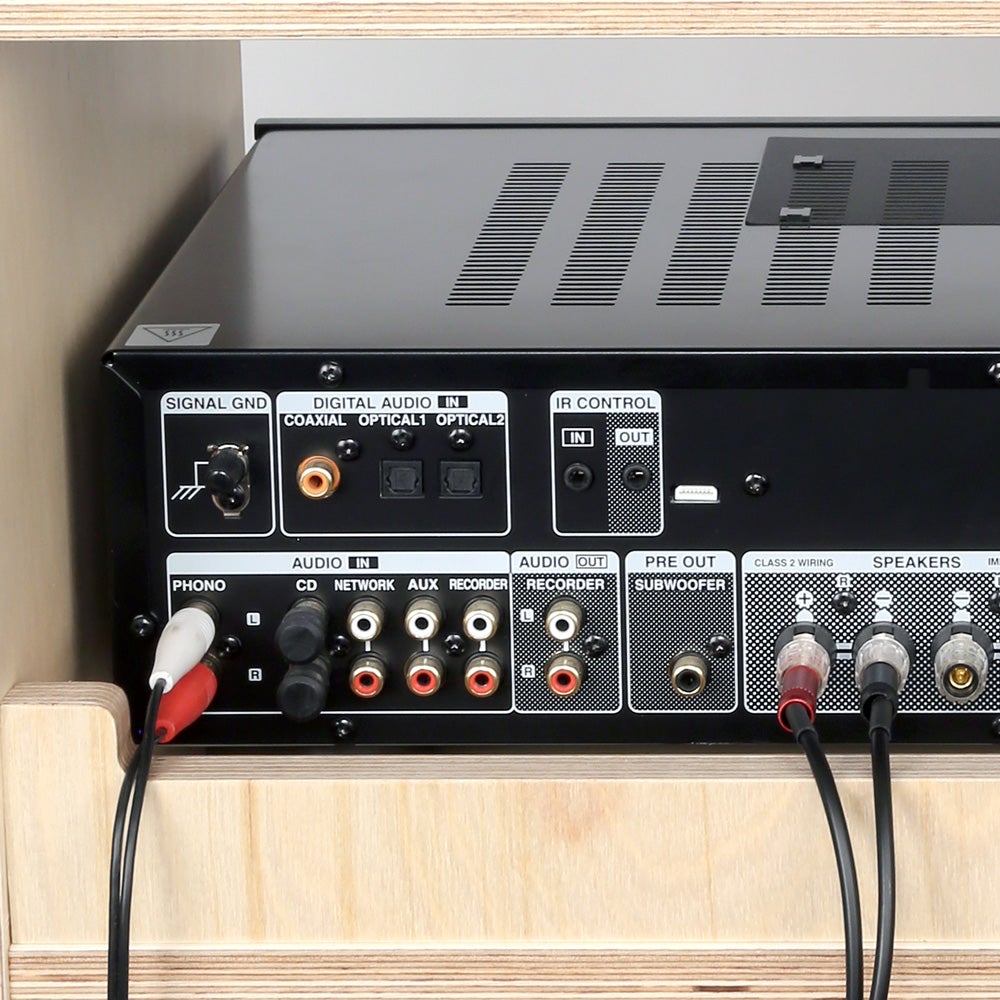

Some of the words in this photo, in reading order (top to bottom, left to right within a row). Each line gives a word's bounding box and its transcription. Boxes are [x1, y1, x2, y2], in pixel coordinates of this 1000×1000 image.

[166, 397, 227, 409] SIGNAL
[232, 397, 267, 409] GND
[314, 397, 377, 409] DIGITAL
[382, 397, 431, 409] AUDIO
[445, 396, 459, 408] IN
[557, 398, 571, 409] IR
[577, 397, 655, 409] CONTROL
[284, 414, 347, 426] COAXIAL
[358, 414, 426, 426] OPTICAL1
[436, 414, 505, 426] OPTICAL2
[570, 432, 585, 443] IN
[620, 432, 650, 443] OUT
[292, 556, 342, 570] AUDIO
[356, 557, 370, 569] IN
[519, 556, 569, 569] AUDIO
[579, 557, 604, 567] OUT
[645, 556, 677, 568] PRE
[682, 556, 716, 568] OUT
[754, 558, 786, 567] CLASS
[788, 558, 796, 567] 2
[798, 558, 834, 567] WIRING
[873, 556, 961, 569] SPEAKERS
[173, 579, 226, 592] PHONO
[296, 579, 318, 592] CD
[334, 579, 395, 592] NETWORK
[408, 579, 439, 591] AUX
[449, 579, 507, 591] RECORDER
[526, 579, 605, 591] RECORDER
[635, 578, 726, 592] SUBWOOFER
[840, 577, 847, 586] R
[250, 614, 258, 624] L
[251, 670, 259, 680] R
[524, 666, 532, 676] R
